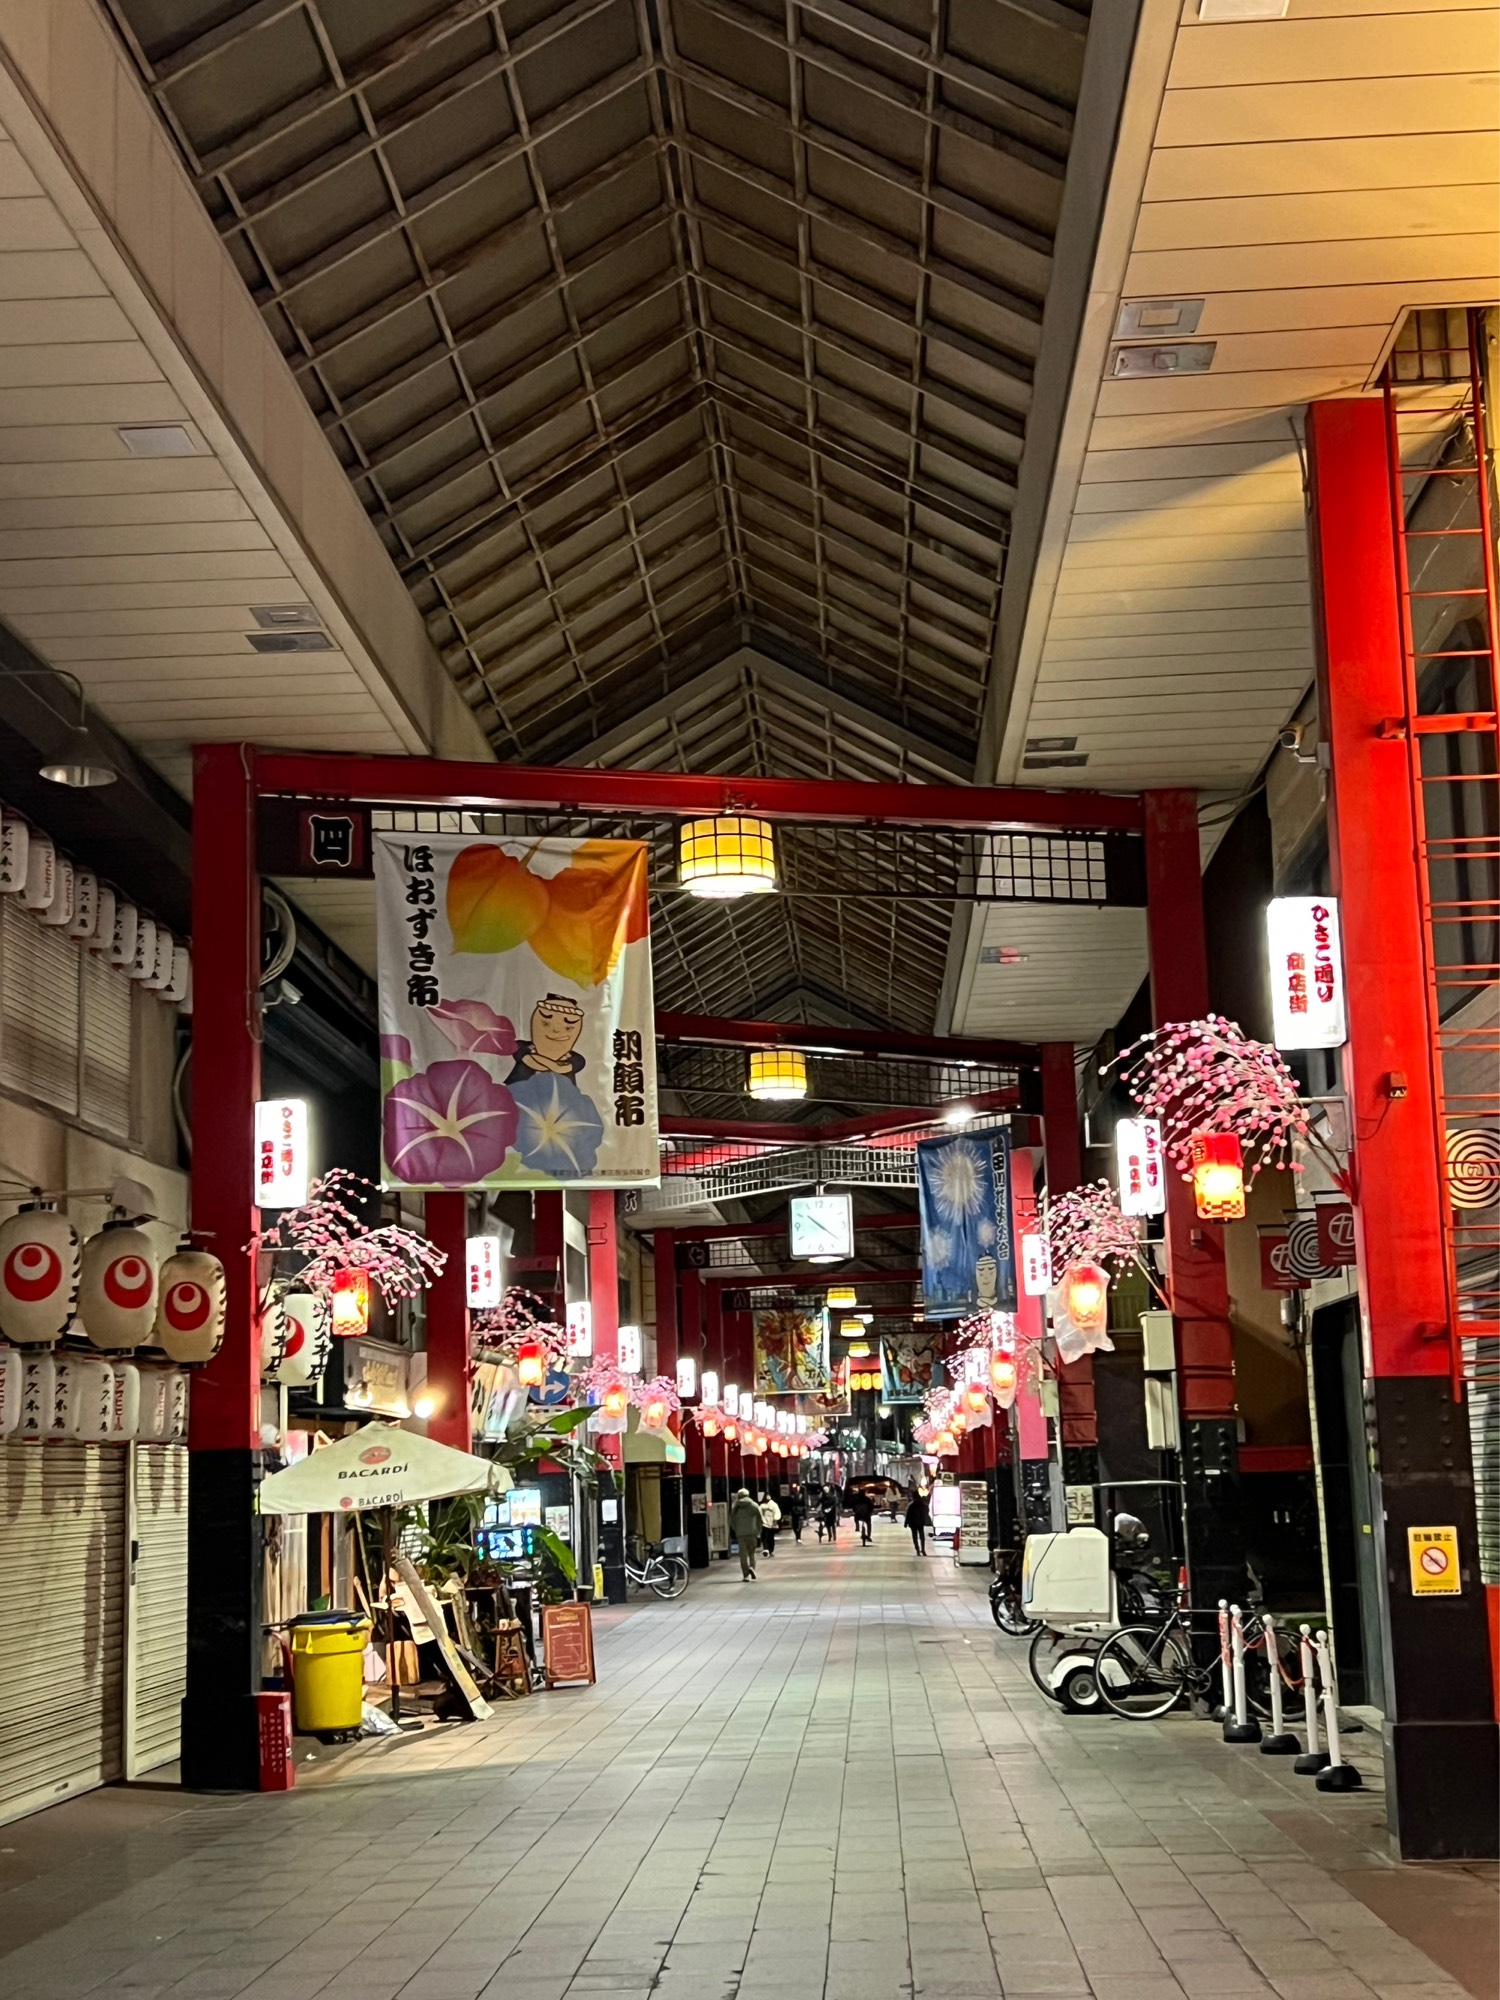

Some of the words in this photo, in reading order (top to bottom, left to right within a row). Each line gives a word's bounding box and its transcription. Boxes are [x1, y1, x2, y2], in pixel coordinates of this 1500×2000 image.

[309, 814, 355, 867] 四
[403, 844, 439, 1008] ほおずき市
[612, 1029, 646, 1128] 朝顔市
[814, 1200, 823, 1209] 12
[337, 1462, 409, 1480] BACARDÍ
